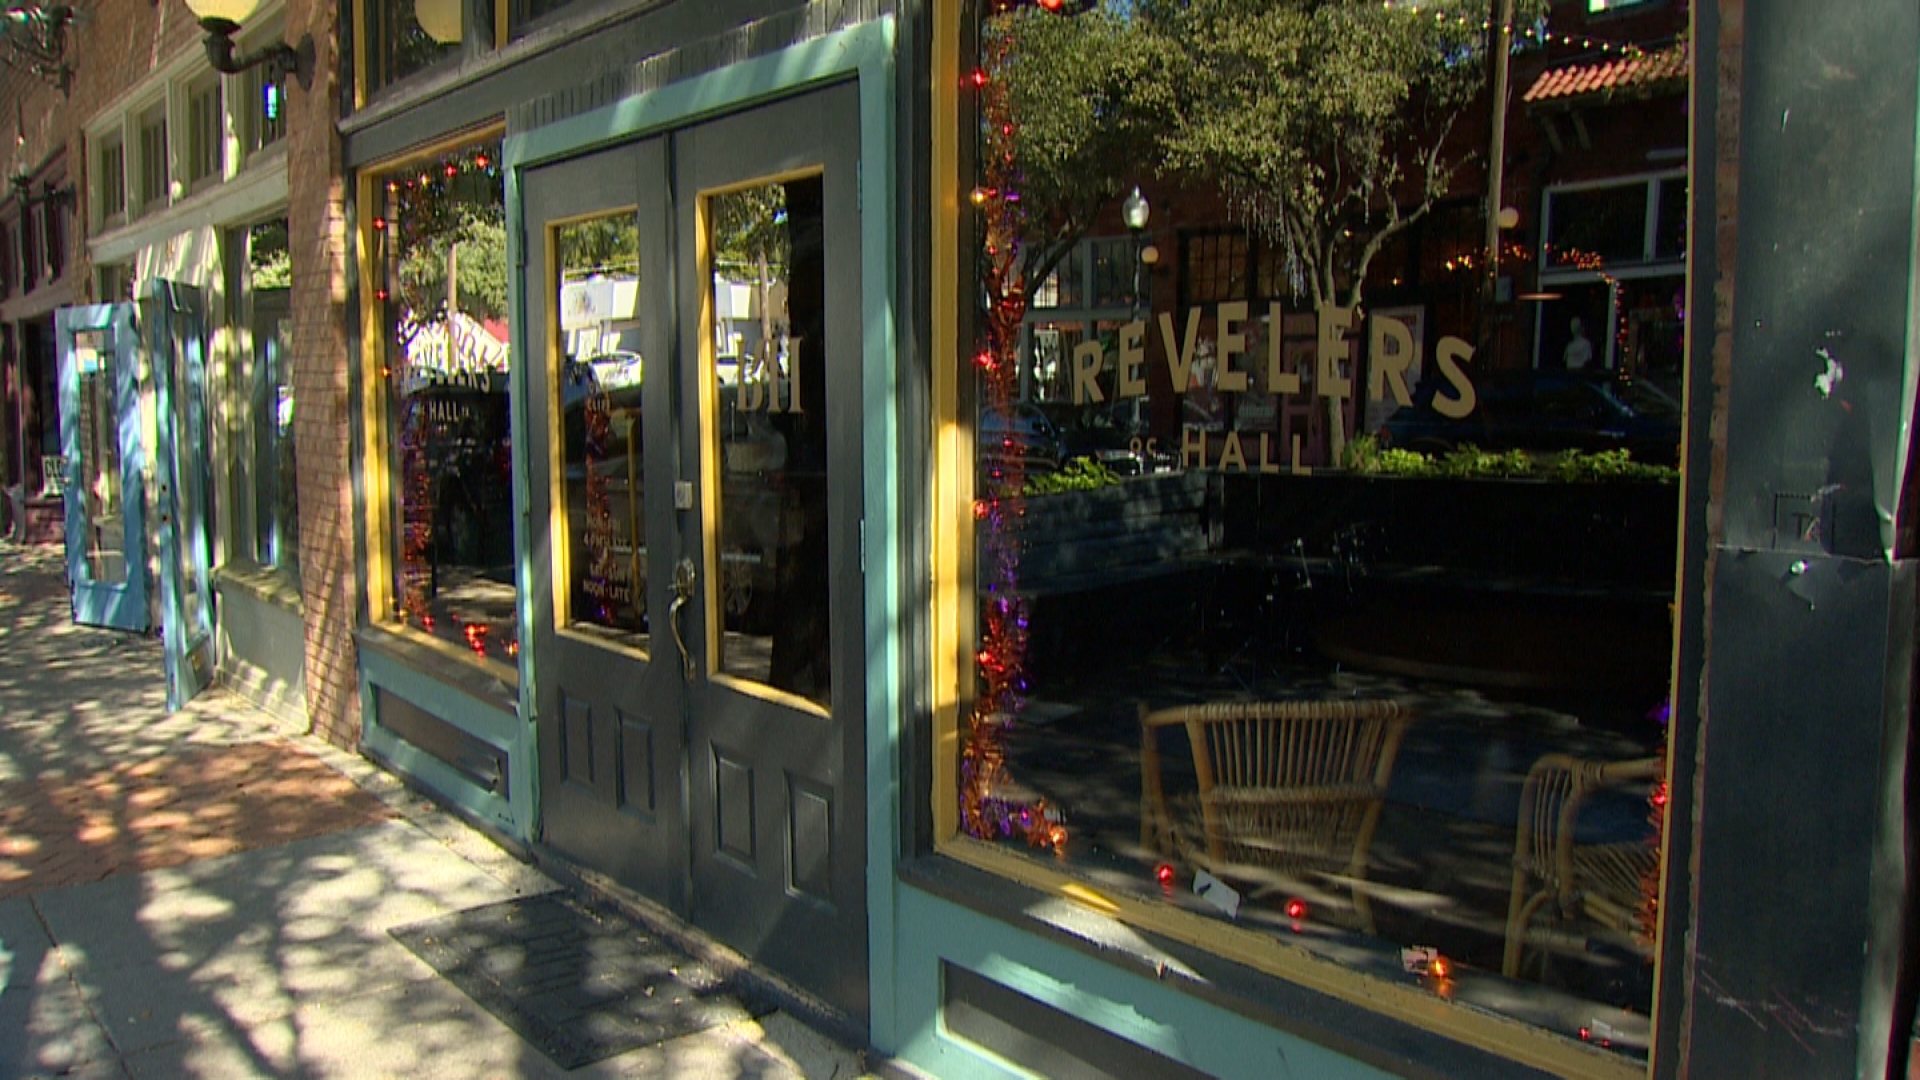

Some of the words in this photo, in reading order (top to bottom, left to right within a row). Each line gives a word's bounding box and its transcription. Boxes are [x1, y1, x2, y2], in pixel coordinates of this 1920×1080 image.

[1073, 301, 1477, 418] REVELERS
[428, 399, 460, 423] HALL
[1182, 427, 1313, 476] HALL
